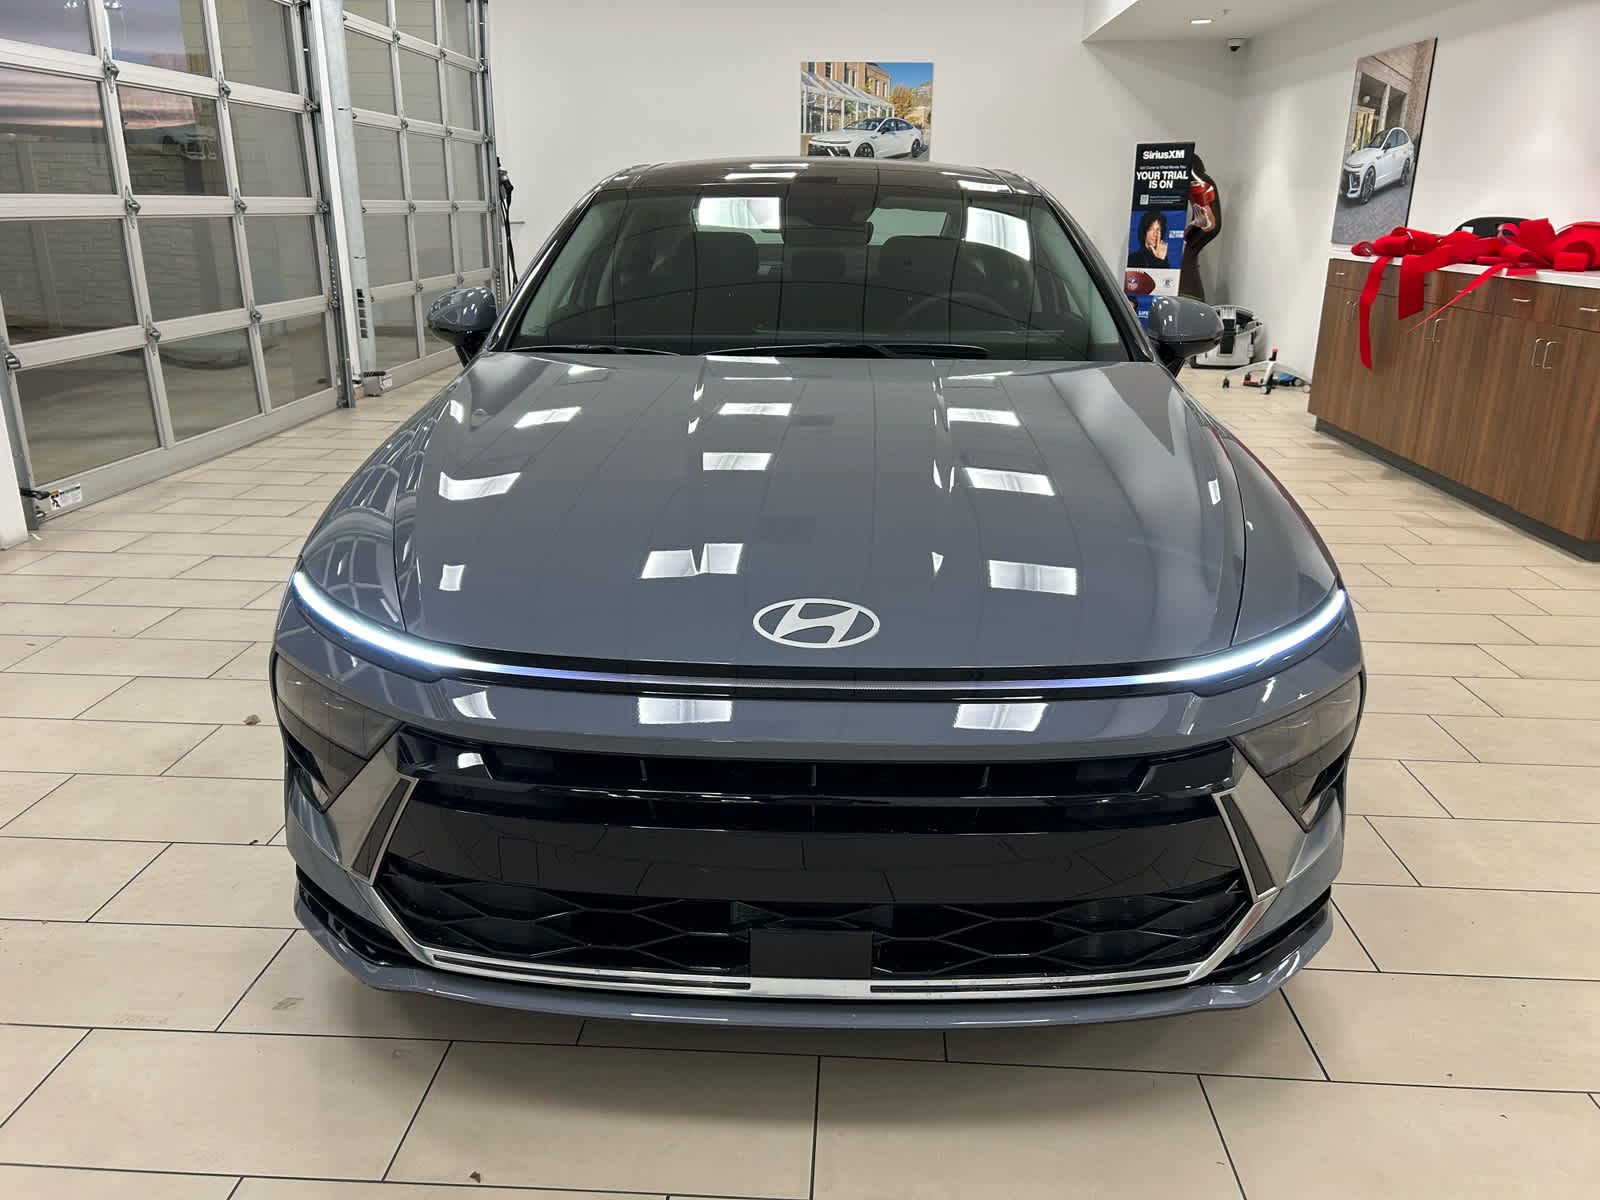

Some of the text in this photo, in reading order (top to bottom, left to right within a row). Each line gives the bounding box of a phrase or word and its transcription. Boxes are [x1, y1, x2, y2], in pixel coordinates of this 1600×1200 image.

[1143, 150, 1185, 160] SiriusXM
[1136, 170, 1189, 180] YOUR TRIAL
[1148, 180, 1174, 189] IS ON
